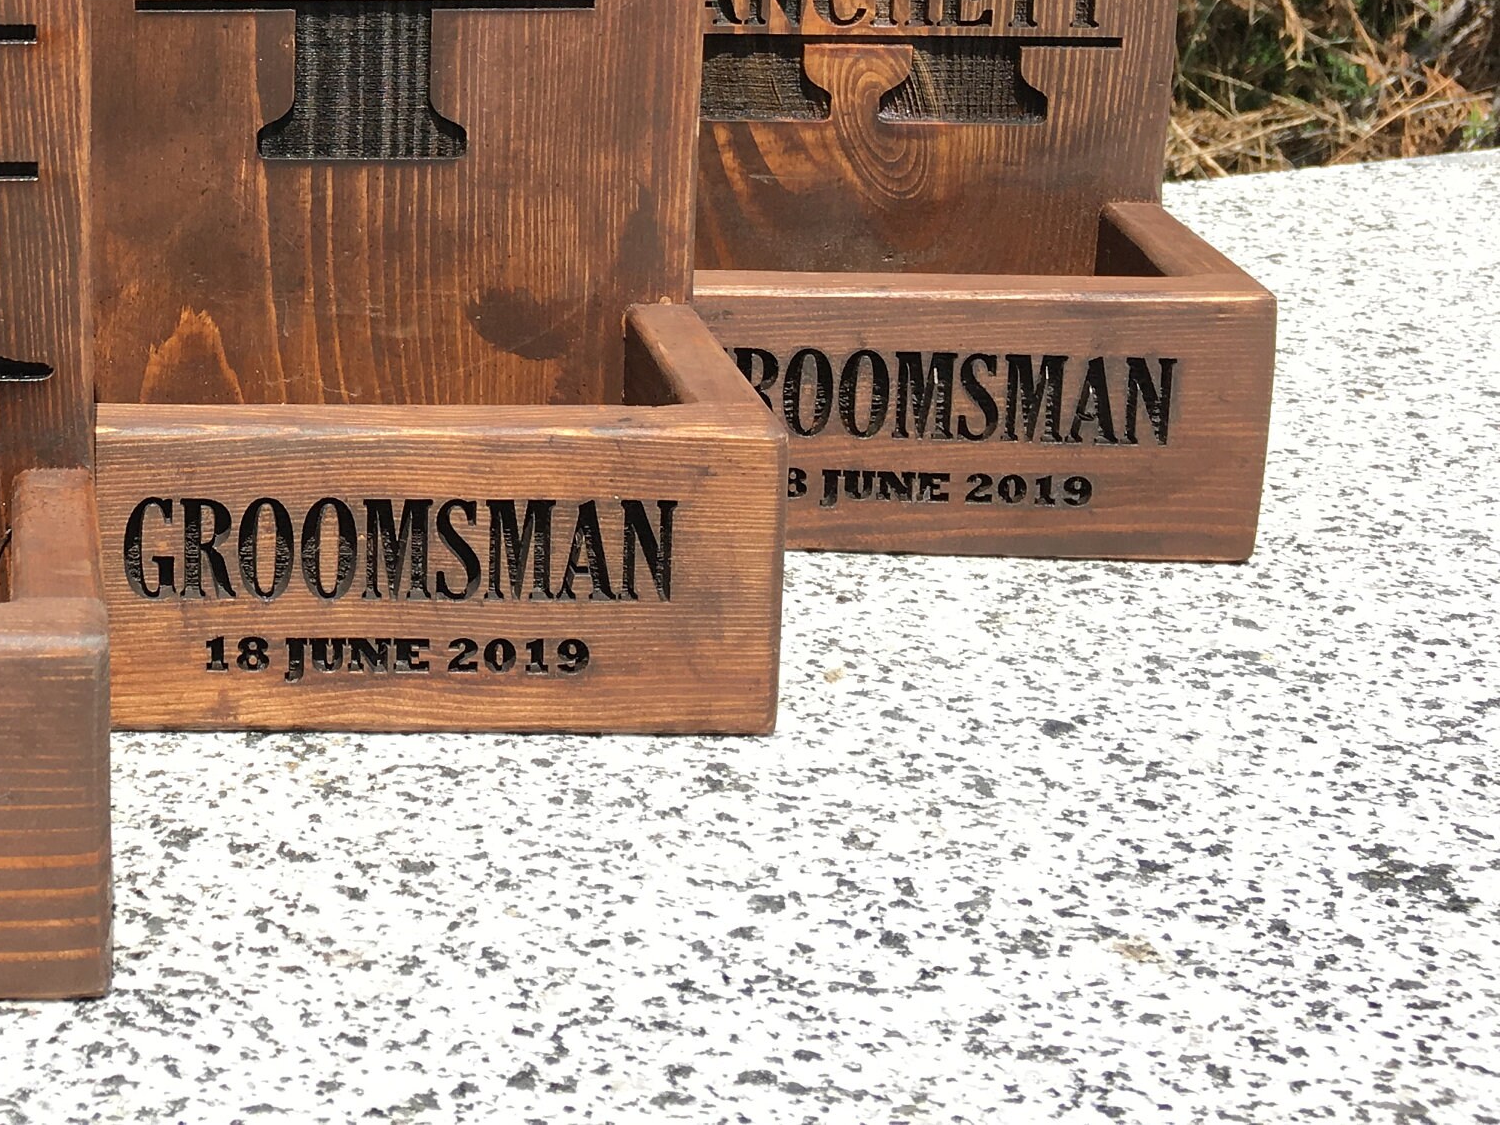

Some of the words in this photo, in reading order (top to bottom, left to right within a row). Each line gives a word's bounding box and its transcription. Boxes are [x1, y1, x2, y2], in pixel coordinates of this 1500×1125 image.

[723, 347, 1177, 445] ROOMSMAN
[819, 468, 950, 508] JUNE
[965, 474, 1093, 507] 2019
[123, 496, 679, 602] GROOMSMAN
[205, 636, 270, 674] 18
[284, 637, 431, 683] JUNE
[447, 637, 591, 674] 2019
